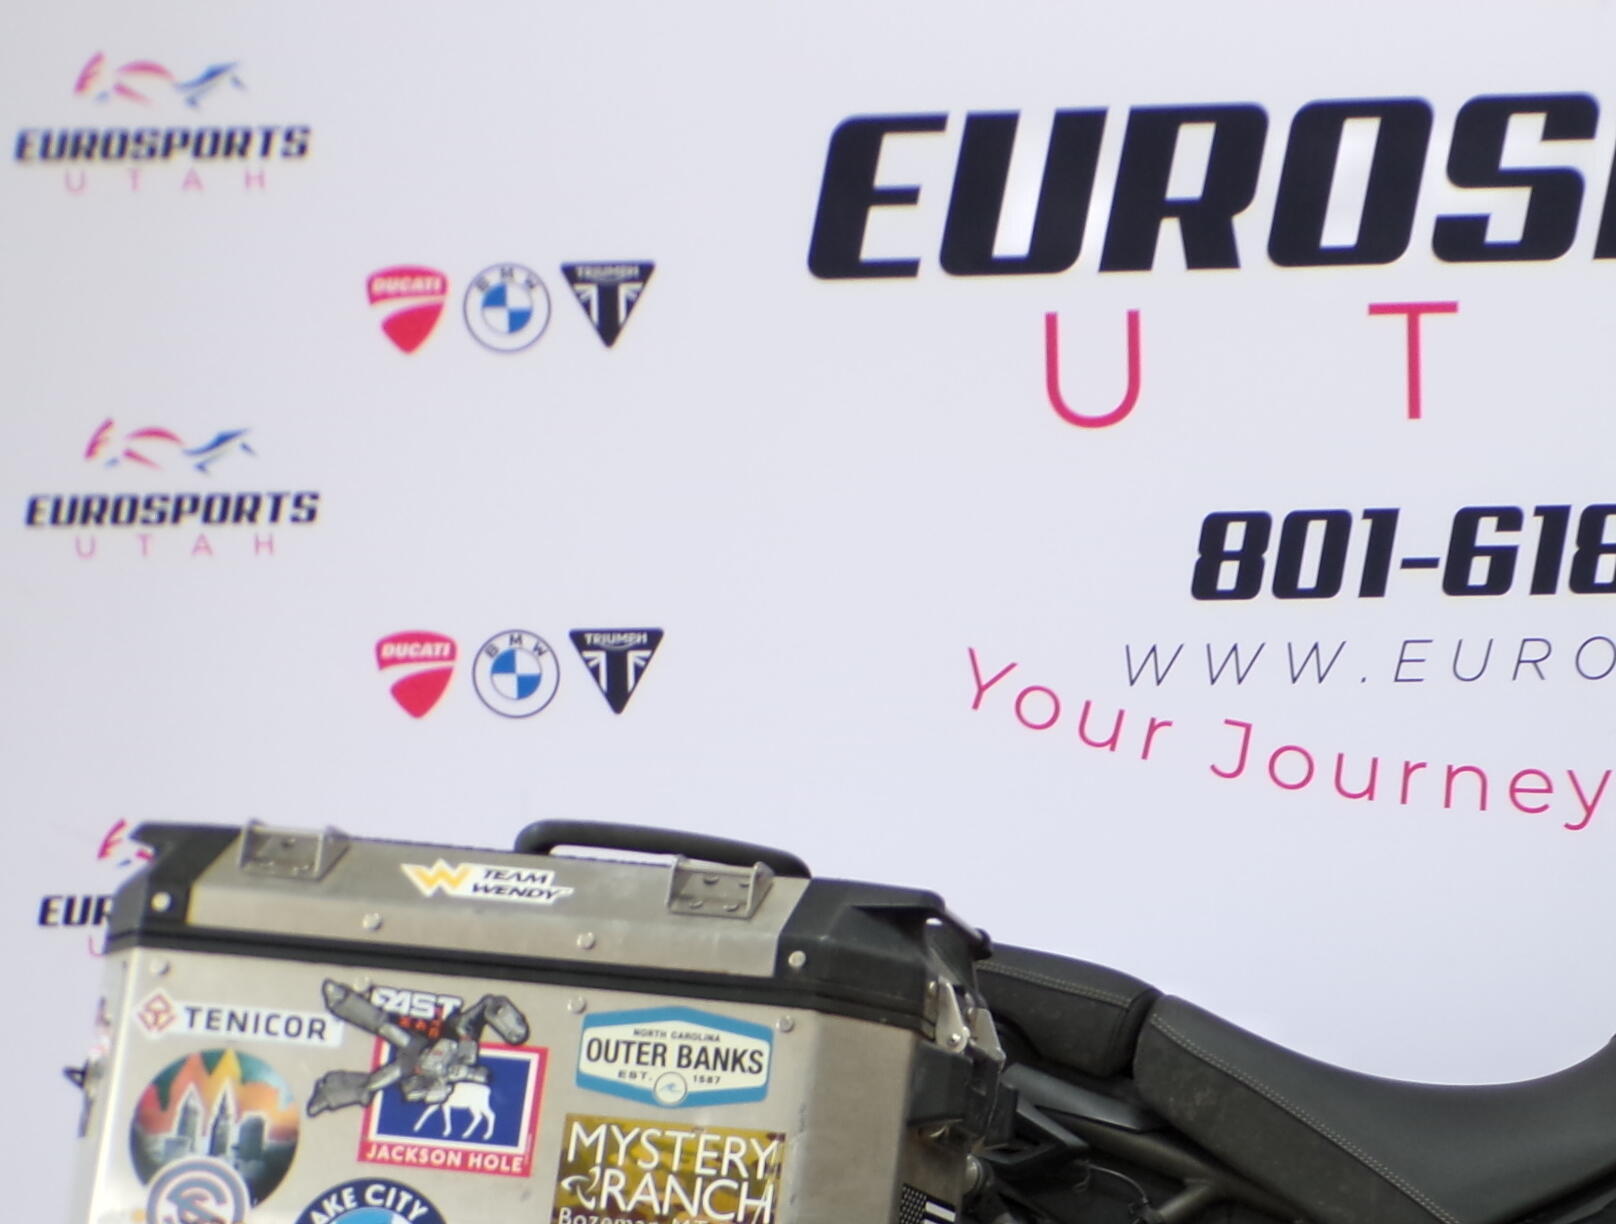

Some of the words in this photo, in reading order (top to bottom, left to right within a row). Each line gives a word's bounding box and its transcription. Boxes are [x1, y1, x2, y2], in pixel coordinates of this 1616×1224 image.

[14, 125, 311, 163] EUROSPORTS
[64, 168, 267, 194] UTAH
[371, 276, 442, 295] DUCATI
[474, 265, 538, 292] BMW
[25, 490, 320, 528] EUROSPORTS
[75, 533, 275, 559] UTAH
[380, 642, 453, 660] DUCATI
[483, 632, 548, 659] BMW
[584, 631, 649, 648] TRIUMPH
[968, 647, 1174, 761] Your
[482, 868, 548, 885] TEAM
[471, 883, 560, 900] WENDY
[184, 1005, 328, 1041] TENICOR
[633, 1028, 667, 1039] NORTH
[671, 1030, 721, 1043] CAROLINA
[585, 1037, 668, 1067] OUTER
[676, 1044, 764, 1075] BANKS
[618, 1070, 653, 1081] EST.
[365, 1143, 463, 1166] JACKSON
[468, 1152, 523, 1173] HOLE
[567, 1121, 780, 1180] MYSTERY
[364, 1184, 428, 1222] CITY
[600, 1168, 775, 1224] RANCH
